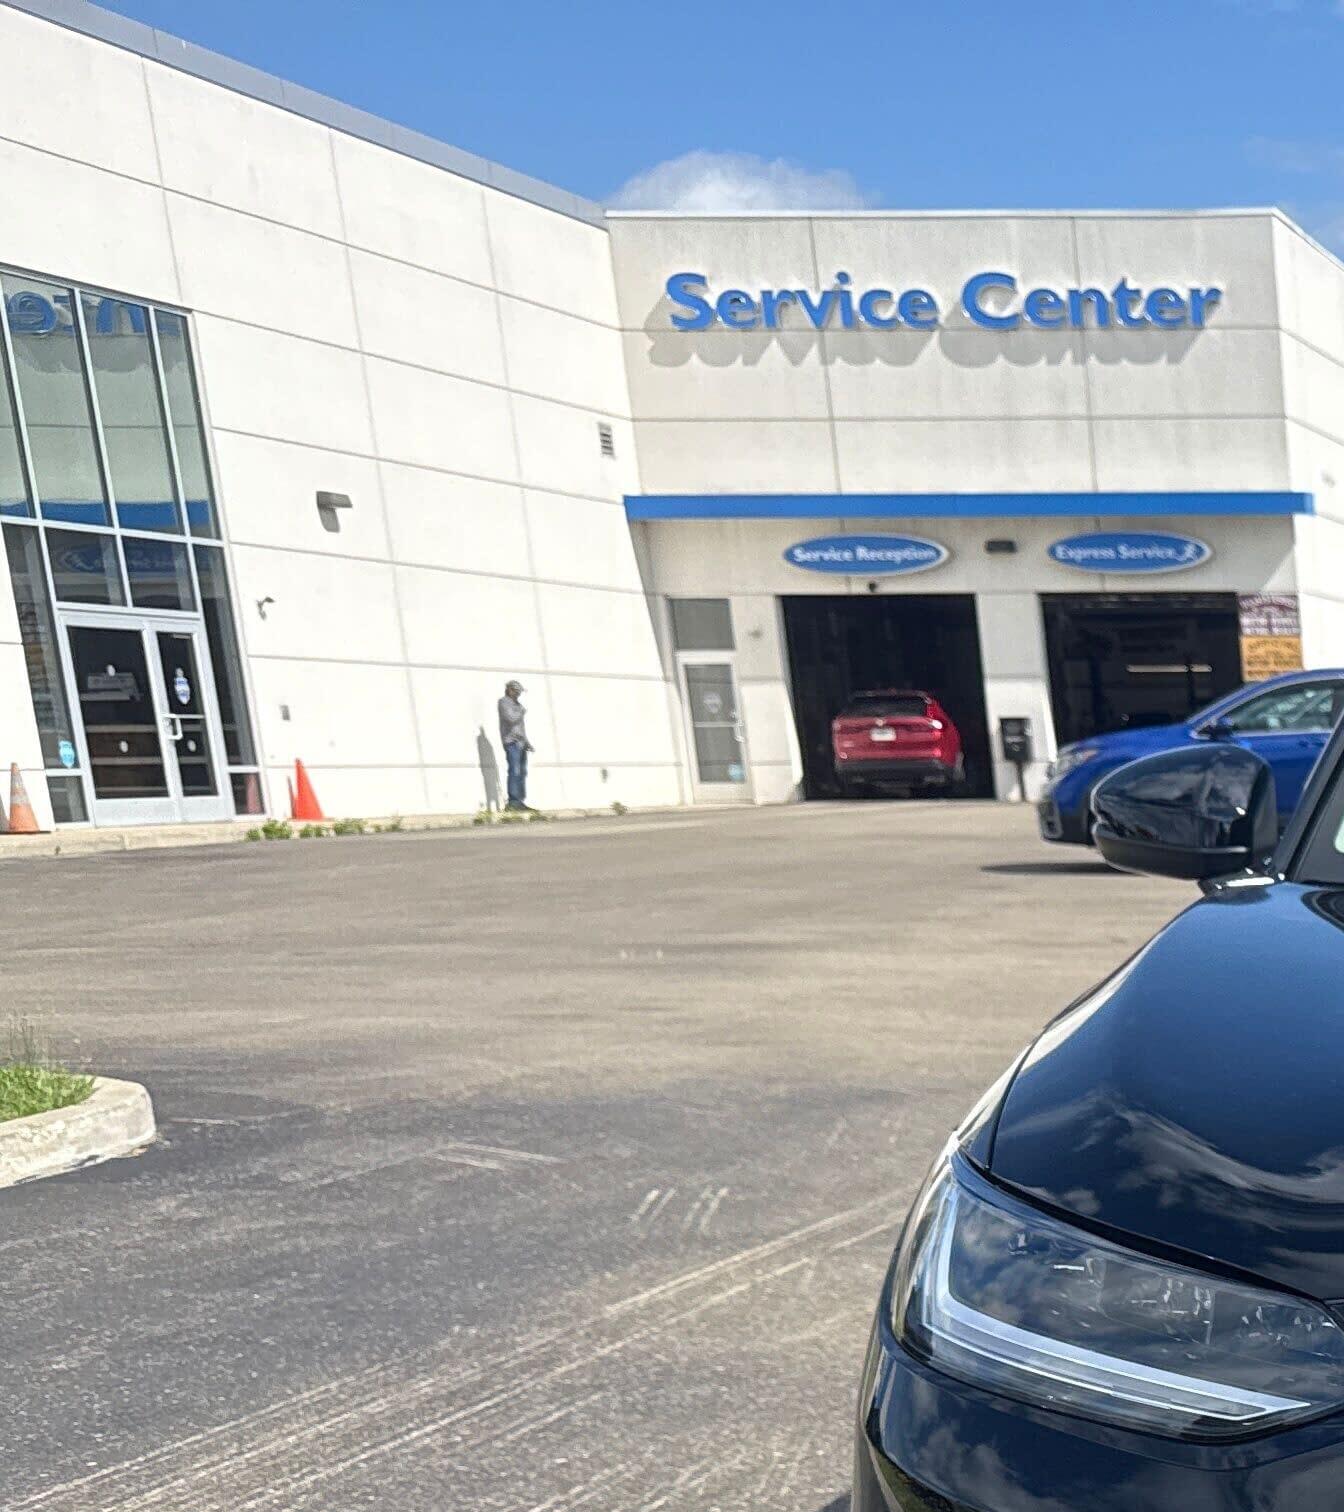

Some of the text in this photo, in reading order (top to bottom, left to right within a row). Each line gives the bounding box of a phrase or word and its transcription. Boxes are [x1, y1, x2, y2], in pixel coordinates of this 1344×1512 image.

[665, 271, 1223, 331] Service Center
[793, 546, 938, 563] Service Reception
[1055, 543, 1175, 562] Express Service
